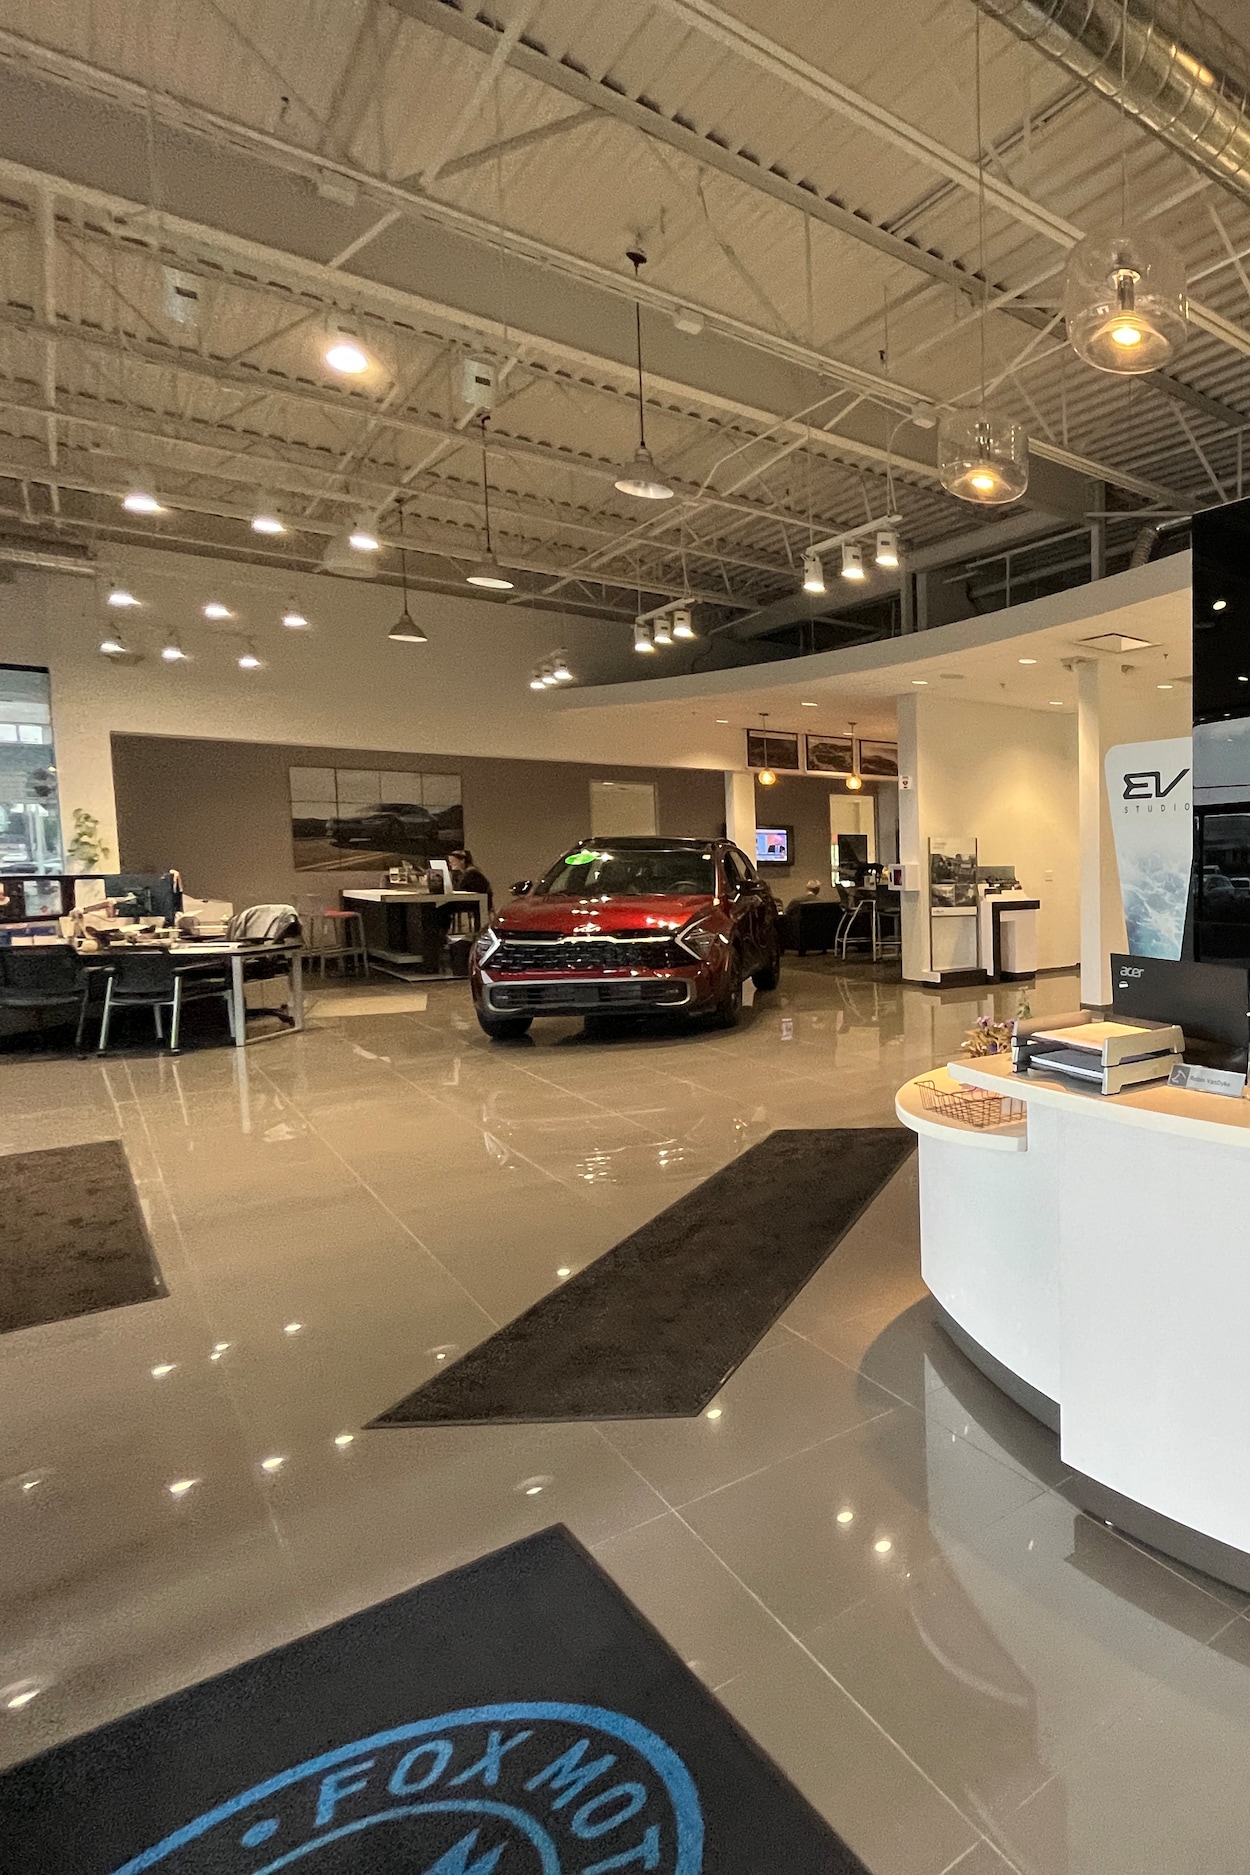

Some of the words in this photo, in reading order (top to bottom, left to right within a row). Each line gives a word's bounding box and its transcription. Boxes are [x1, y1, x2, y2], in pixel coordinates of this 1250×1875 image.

[1123, 768, 1190, 800] EV
[1124, 803, 1190, 814] STUDIO
[1120, 966, 1145, 978] acer
[312, 1730, 536, 1828] FOX
[524, 1738, 662, 1875] MOT
